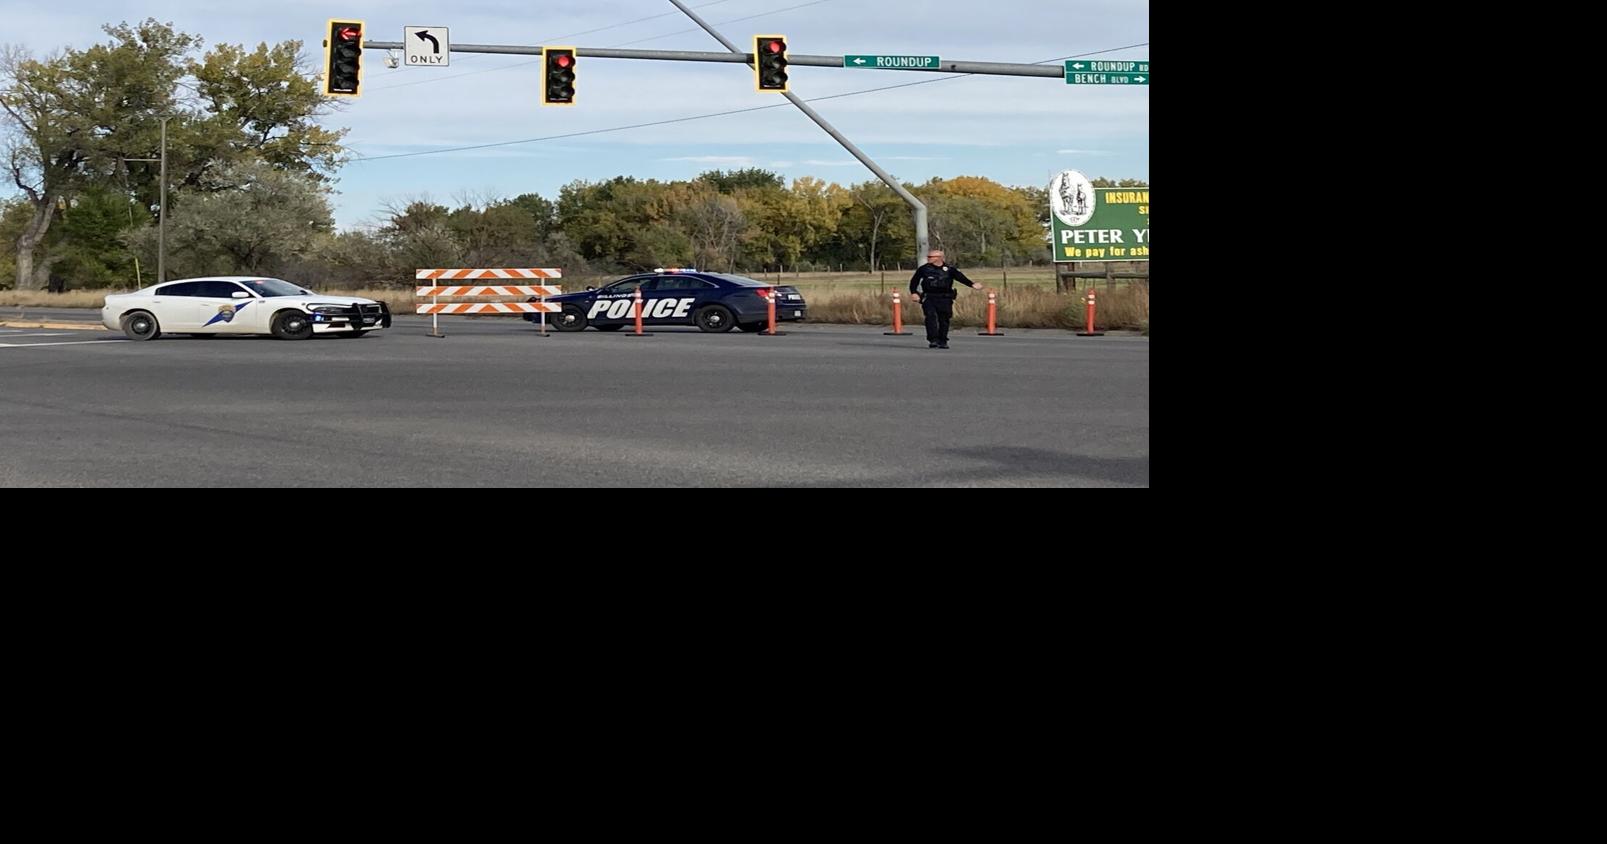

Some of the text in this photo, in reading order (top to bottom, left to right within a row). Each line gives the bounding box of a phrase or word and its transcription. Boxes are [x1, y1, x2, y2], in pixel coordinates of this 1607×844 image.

[410, 55, 443, 64] ONLY
[876, 56, 932, 67] ROUNDUP
[1091, 62, 1136, 71] ROUNDUP
[1074, 74, 1106, 83] BENCH
[1060, 229, 1149, 244] PETER Y
[1064, 246, 1081, 257] We
[1086, 248, 1105, 258] pay
[1109, 246, 1125, 256] for
[587, 298, 695, 318] POLICE
